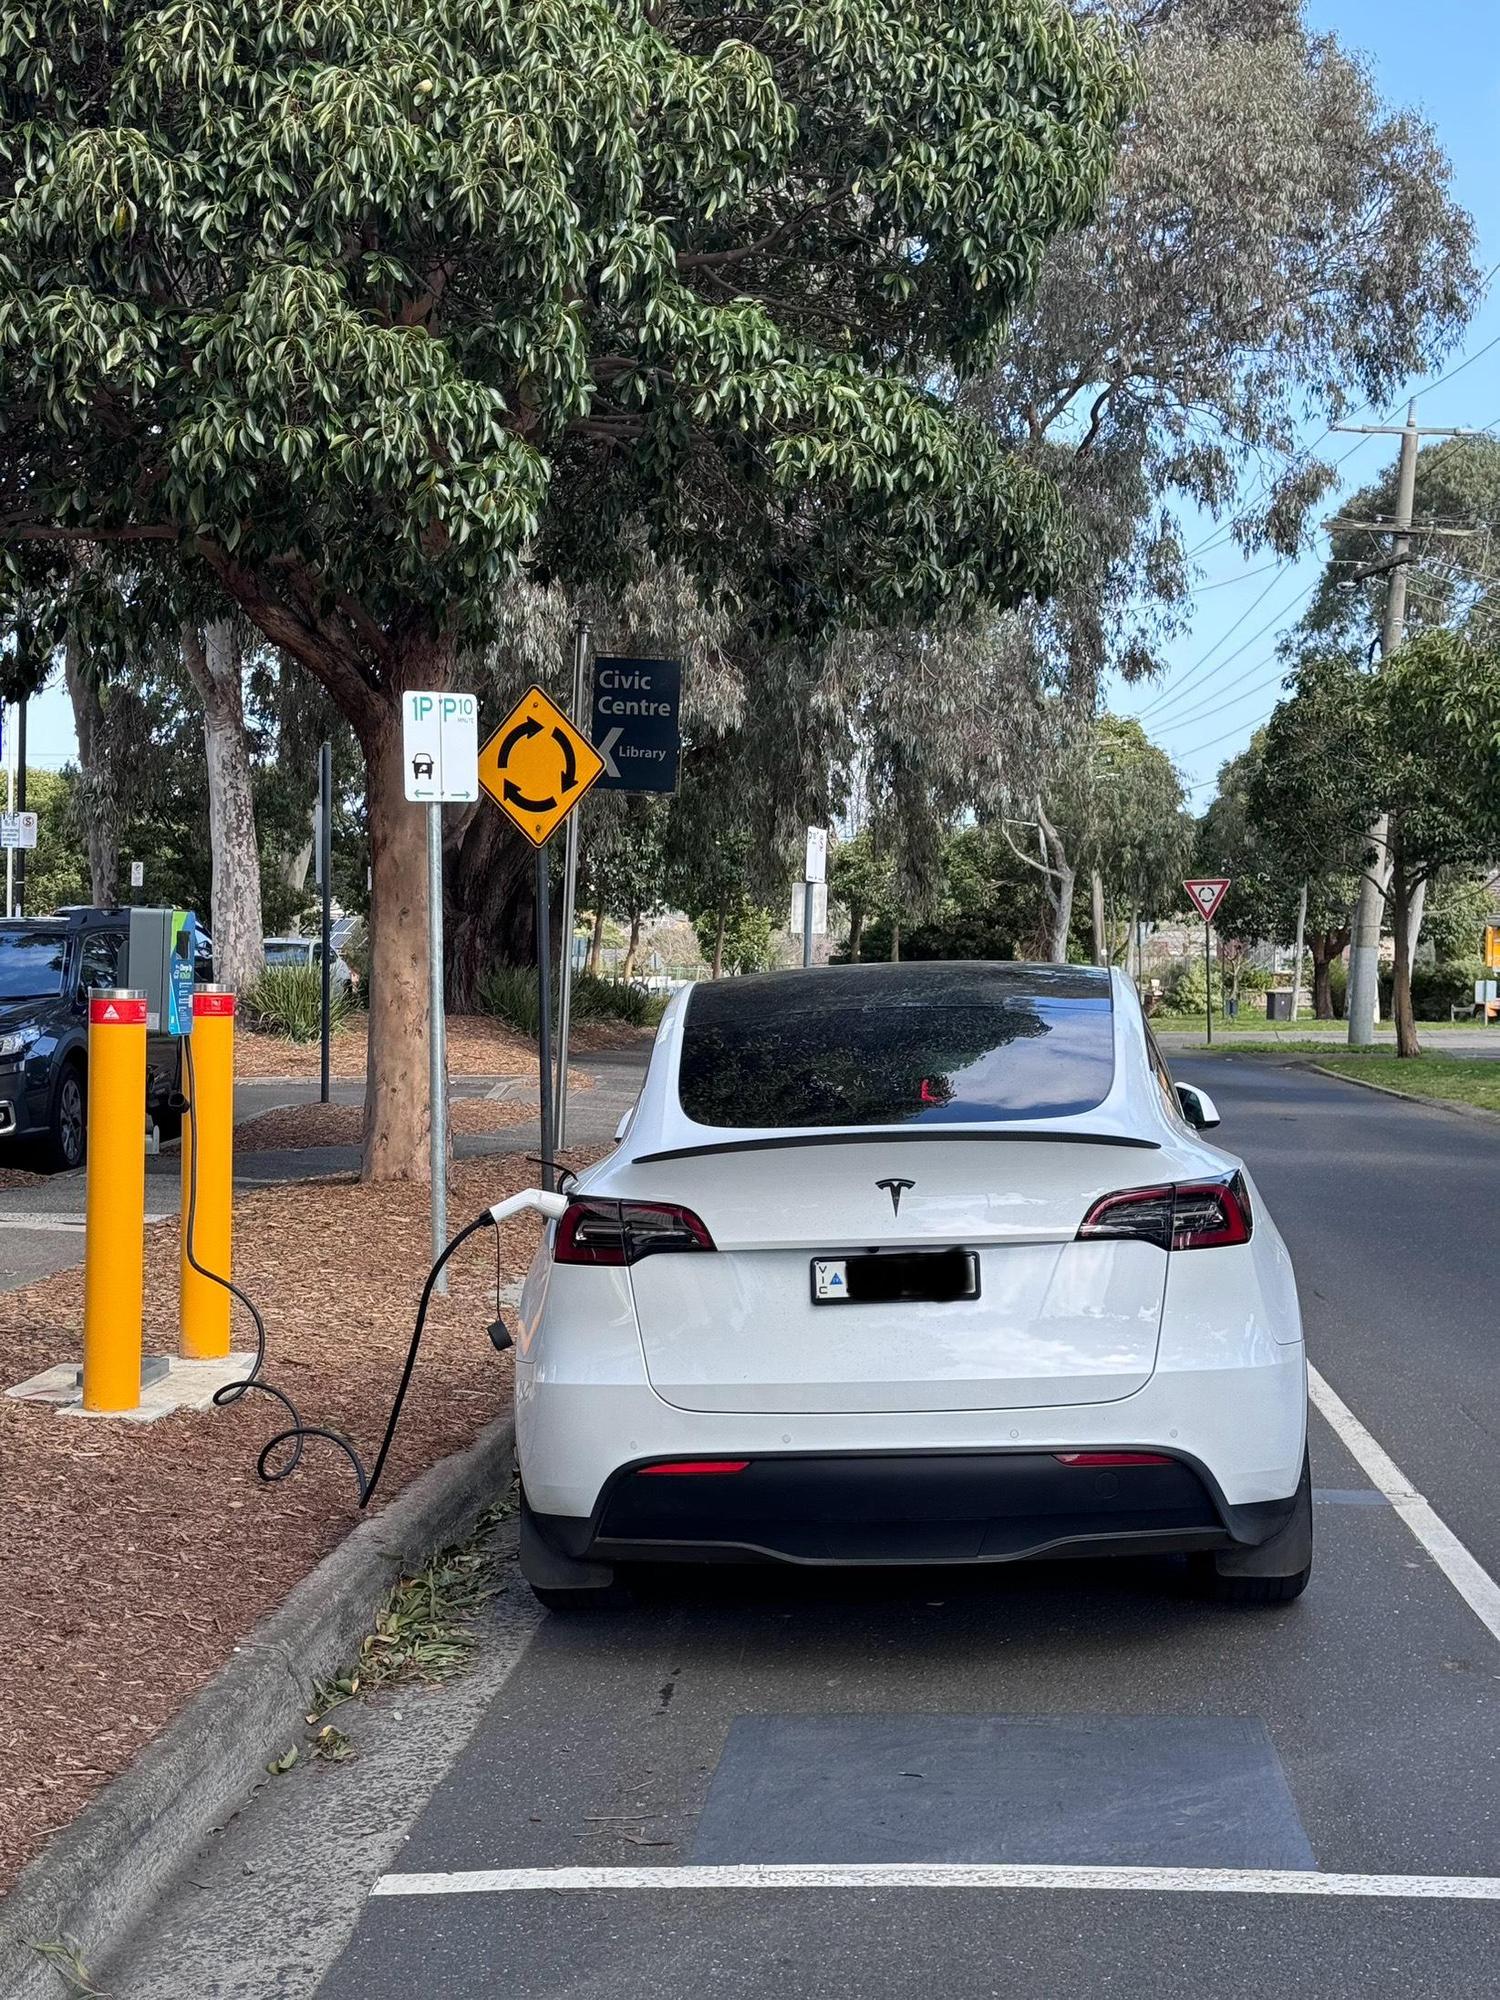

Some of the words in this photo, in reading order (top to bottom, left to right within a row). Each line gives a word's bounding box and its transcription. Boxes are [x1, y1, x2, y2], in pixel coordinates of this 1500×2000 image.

[599, 670, 651, 690] Civic
[412, 696, 433, 721] 1P
[598, 696, 671, 716] Centre
[619, 746, 666, 762] Library
